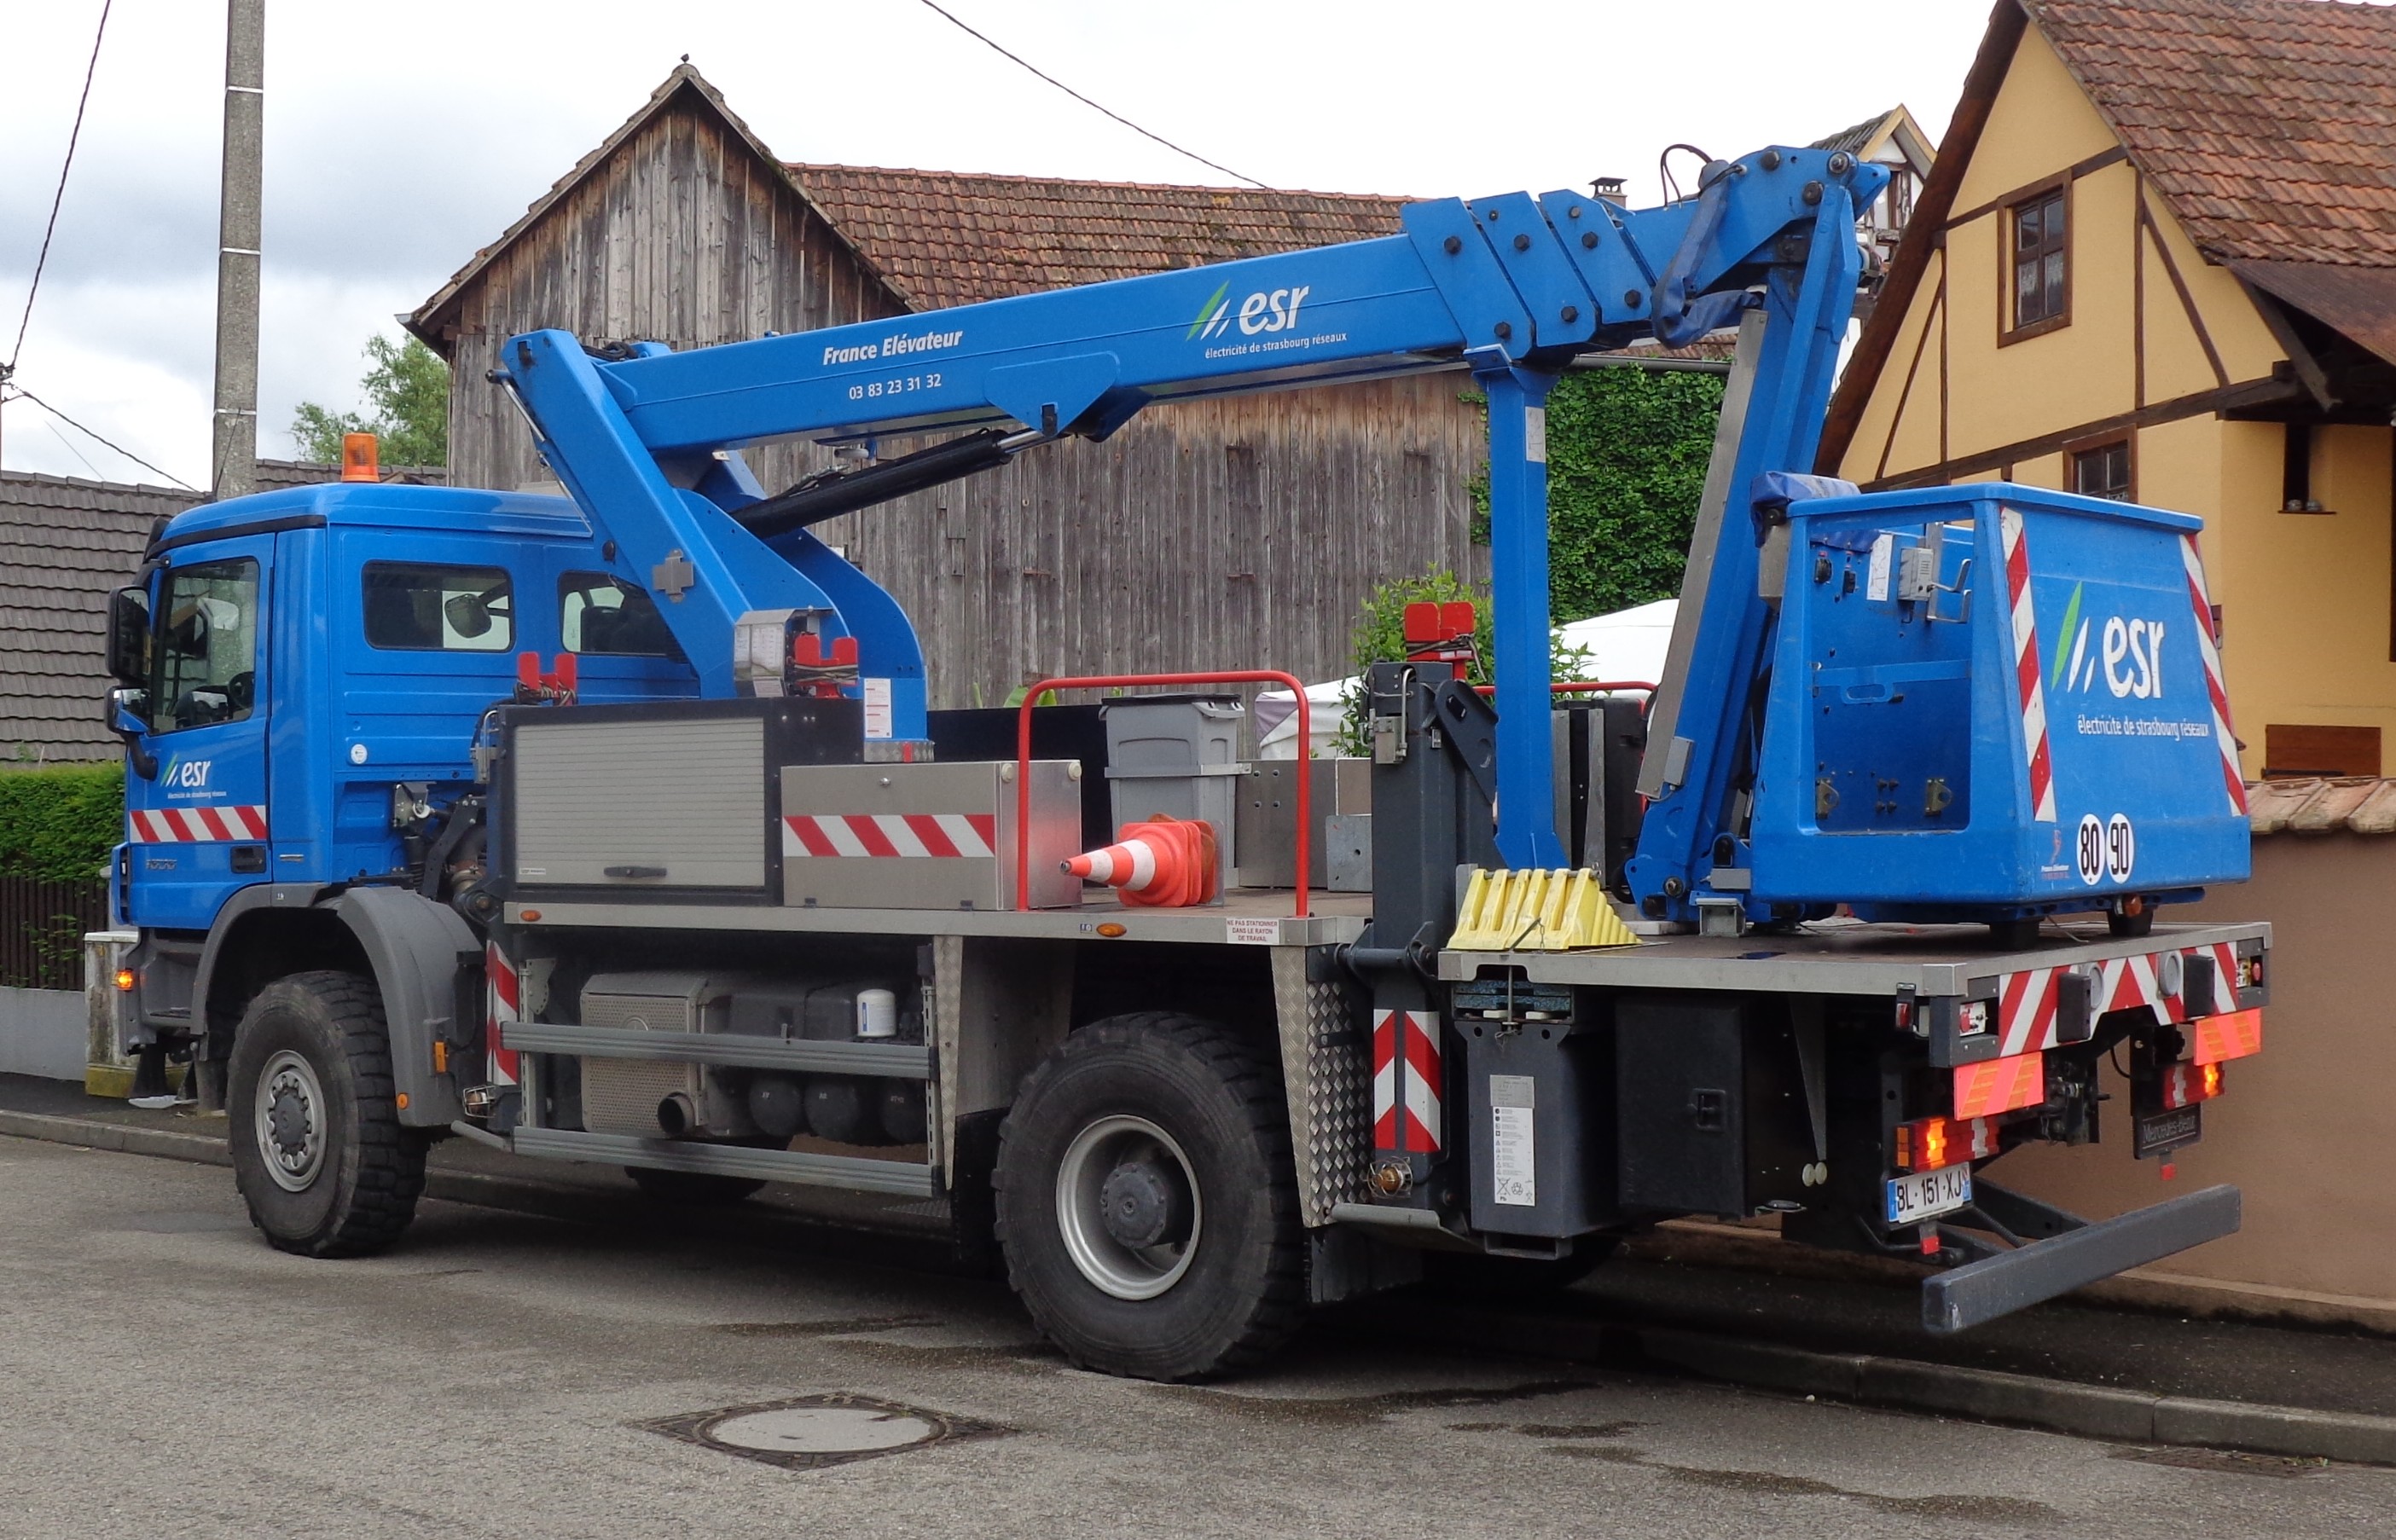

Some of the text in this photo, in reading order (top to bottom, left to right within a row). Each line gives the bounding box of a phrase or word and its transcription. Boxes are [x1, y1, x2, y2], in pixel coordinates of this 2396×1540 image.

[1239, 285, 1310, 335] esr
[822, 331, 963, 366] France Elévateur
[1204, 333, 1348, 359] électricité de strasbourg réseaux
[849, 373, 942, 400] 03 83 23 31 32
[2103, 616, 2165, 699] esr
[2077, 714, 2209, 741] électricité de strasbourg réseaux
[181, 761, 212, 787] esr
[2080, 823, 2100, 876] 80
[2109, 822, 2129, 876] 90
